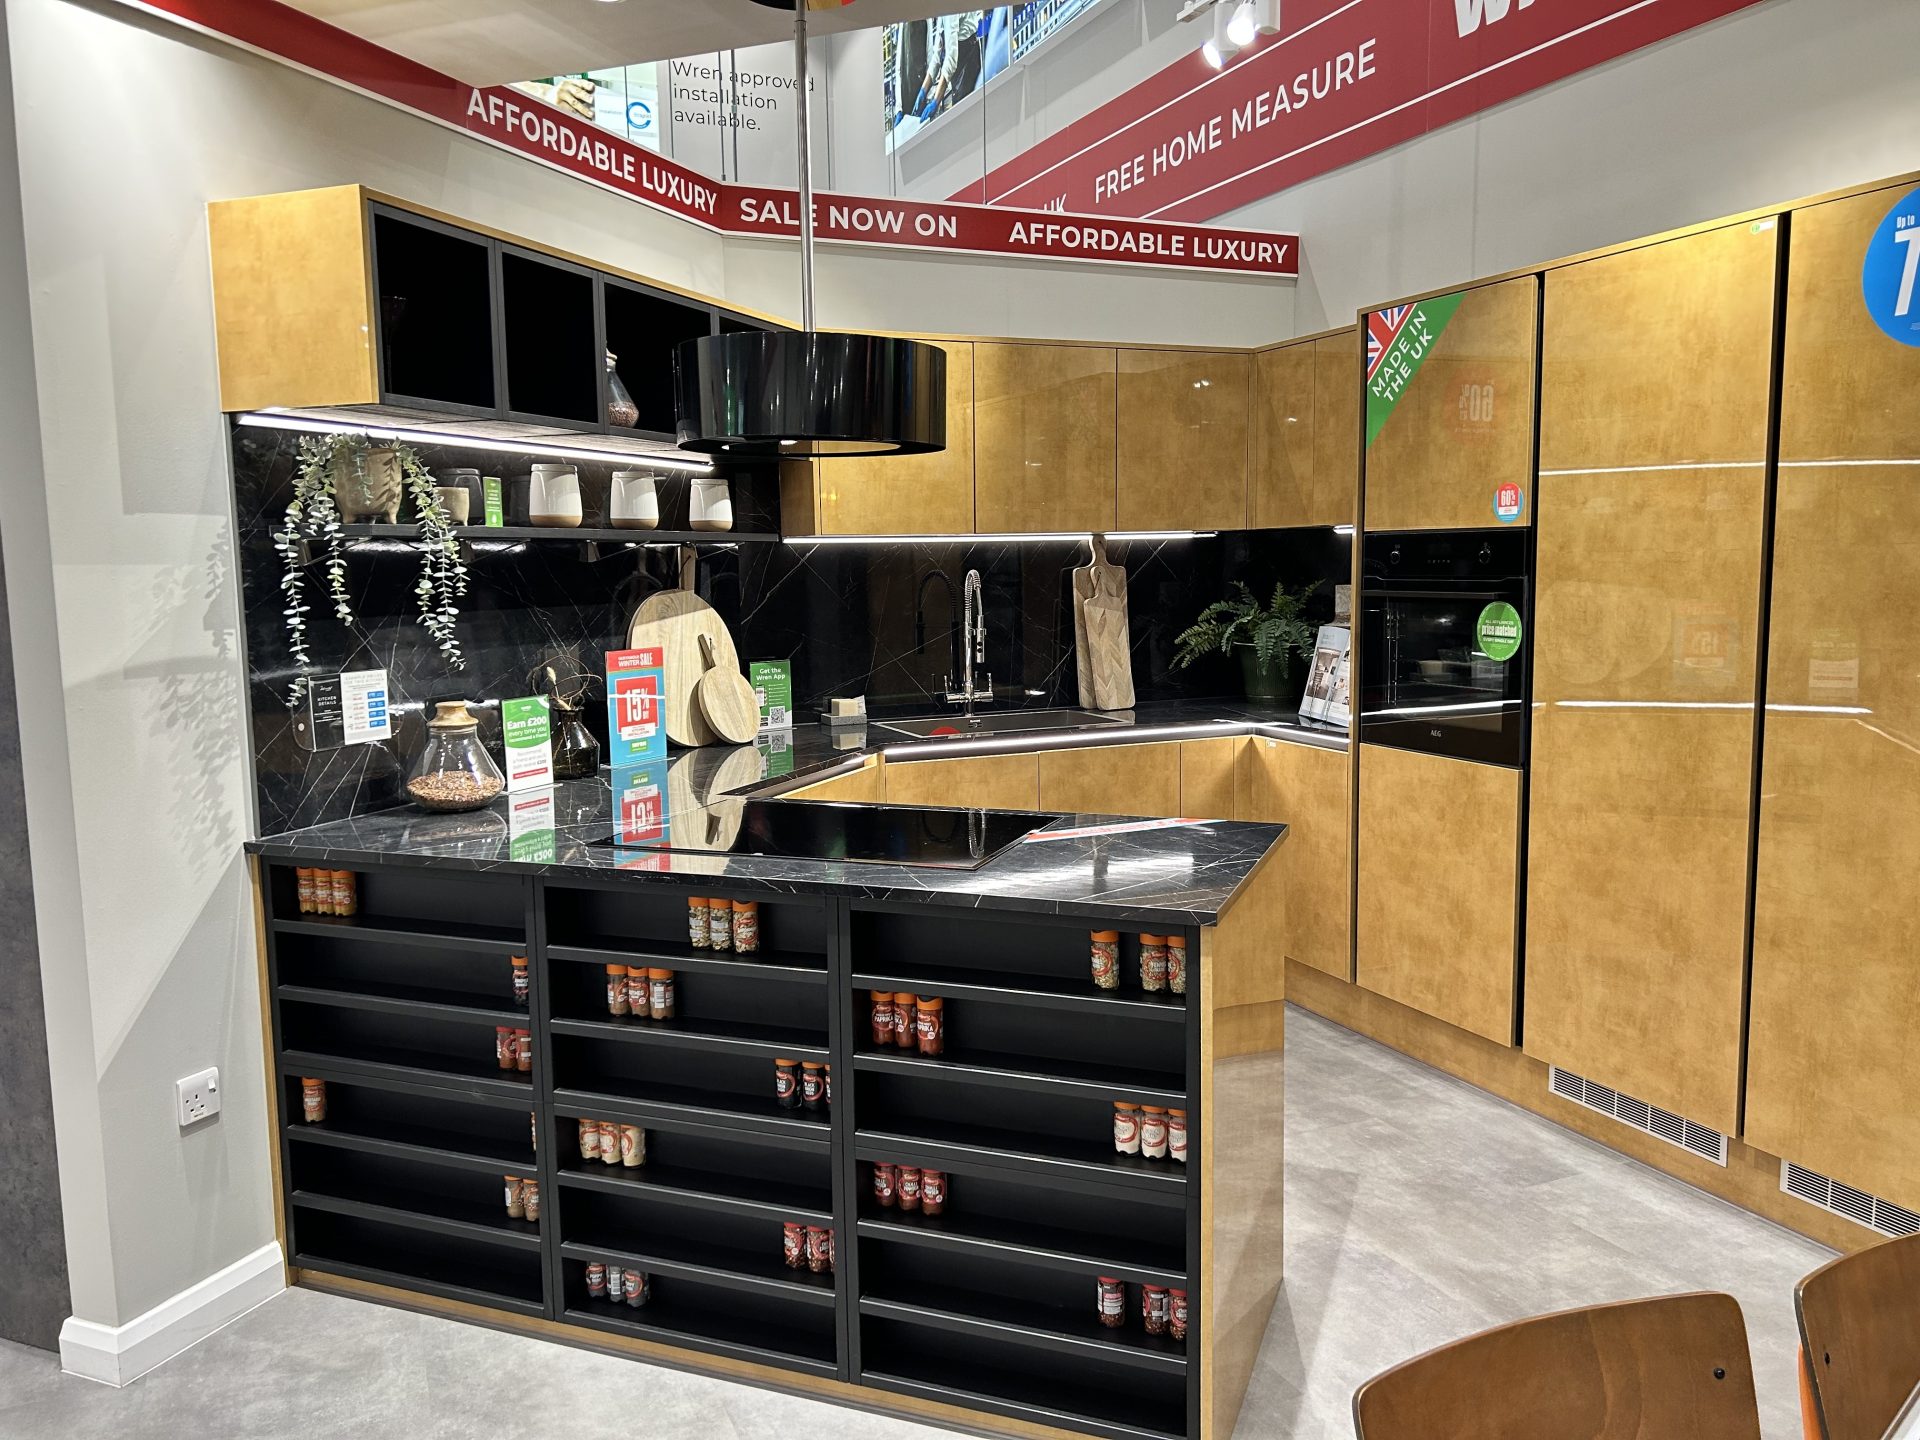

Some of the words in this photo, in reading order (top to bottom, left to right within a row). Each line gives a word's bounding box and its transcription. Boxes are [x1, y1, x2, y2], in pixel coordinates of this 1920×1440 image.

[672, 60, 723, 81] Wren
[673, 83, 778, 111] installation
[674, 109, 762, 131] available.
[1094, 154, 1145, 204] FREE
[1152, 115, 1222, 177] HOME
[1231, 37, 1377, 140] MEASURE
[466, 87, 637, 183] AFFORDABLE
[641, 161, 718, 215] LUXURY
[828, 205, 905, 234] NOW
[914, 213, 957, 239] ON
[1908, 216, 1914, 226] to
[1008, 221, 1185, 257] AFFORDABLE
[1193, 236, 1289, 264] LUXURY
[1372, 336, 1410, 398] MADE
[1409, 310, 1427, 337] IN
[1383, 361, 1412, 402] THE
[1410, 327, 1433, 360] UK
[640, 652, 652, 666] SALE
[506, 720, 526, 730] Earn
[528, 716, 548, 726] £200
